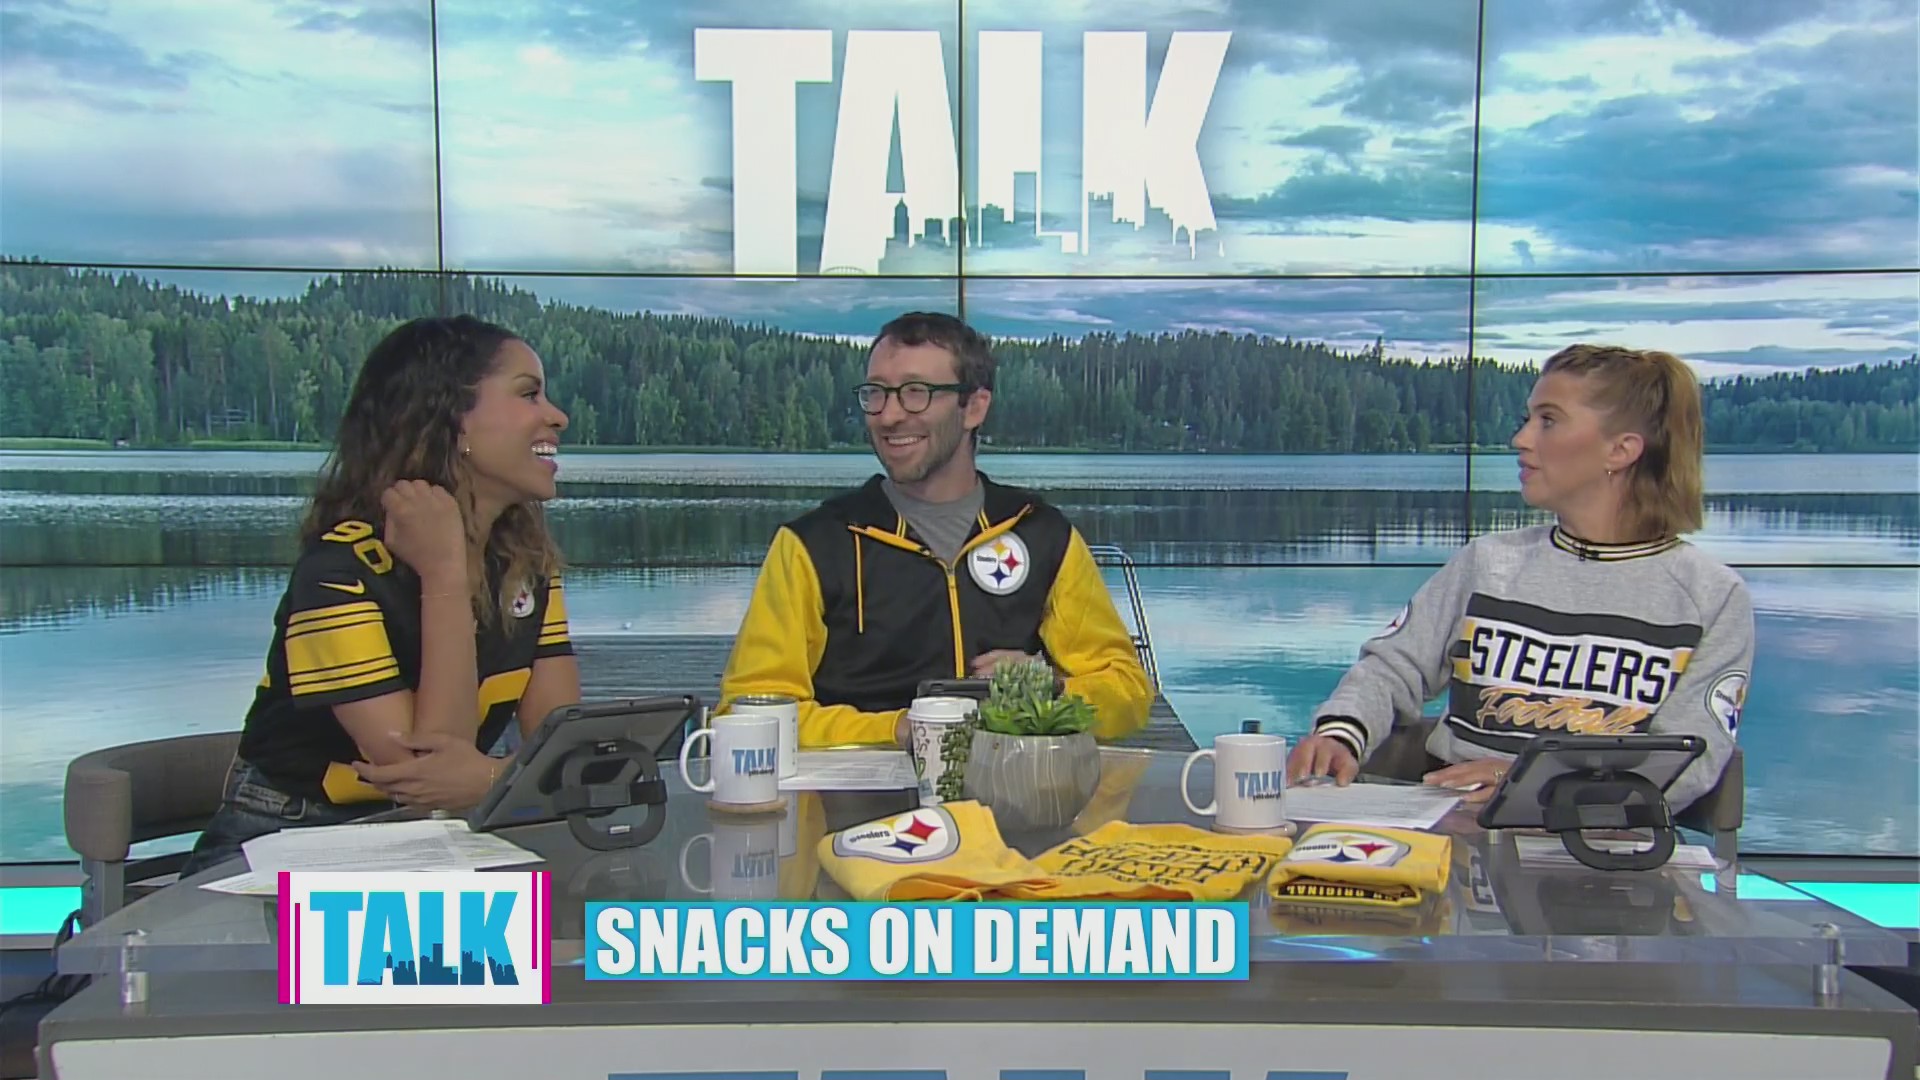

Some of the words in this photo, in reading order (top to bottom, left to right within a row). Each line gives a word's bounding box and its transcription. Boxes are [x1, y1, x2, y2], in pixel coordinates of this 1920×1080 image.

[694, 28, 1232, 281] TALK
[321, 520, 393, 575] 90
[1470, 626, 1671, 705] STEELERS
[1477, 685, 1653, 735] Football
[732, 748, 776, 776] TALK
[1234, 771, 1282, 799] TALK
